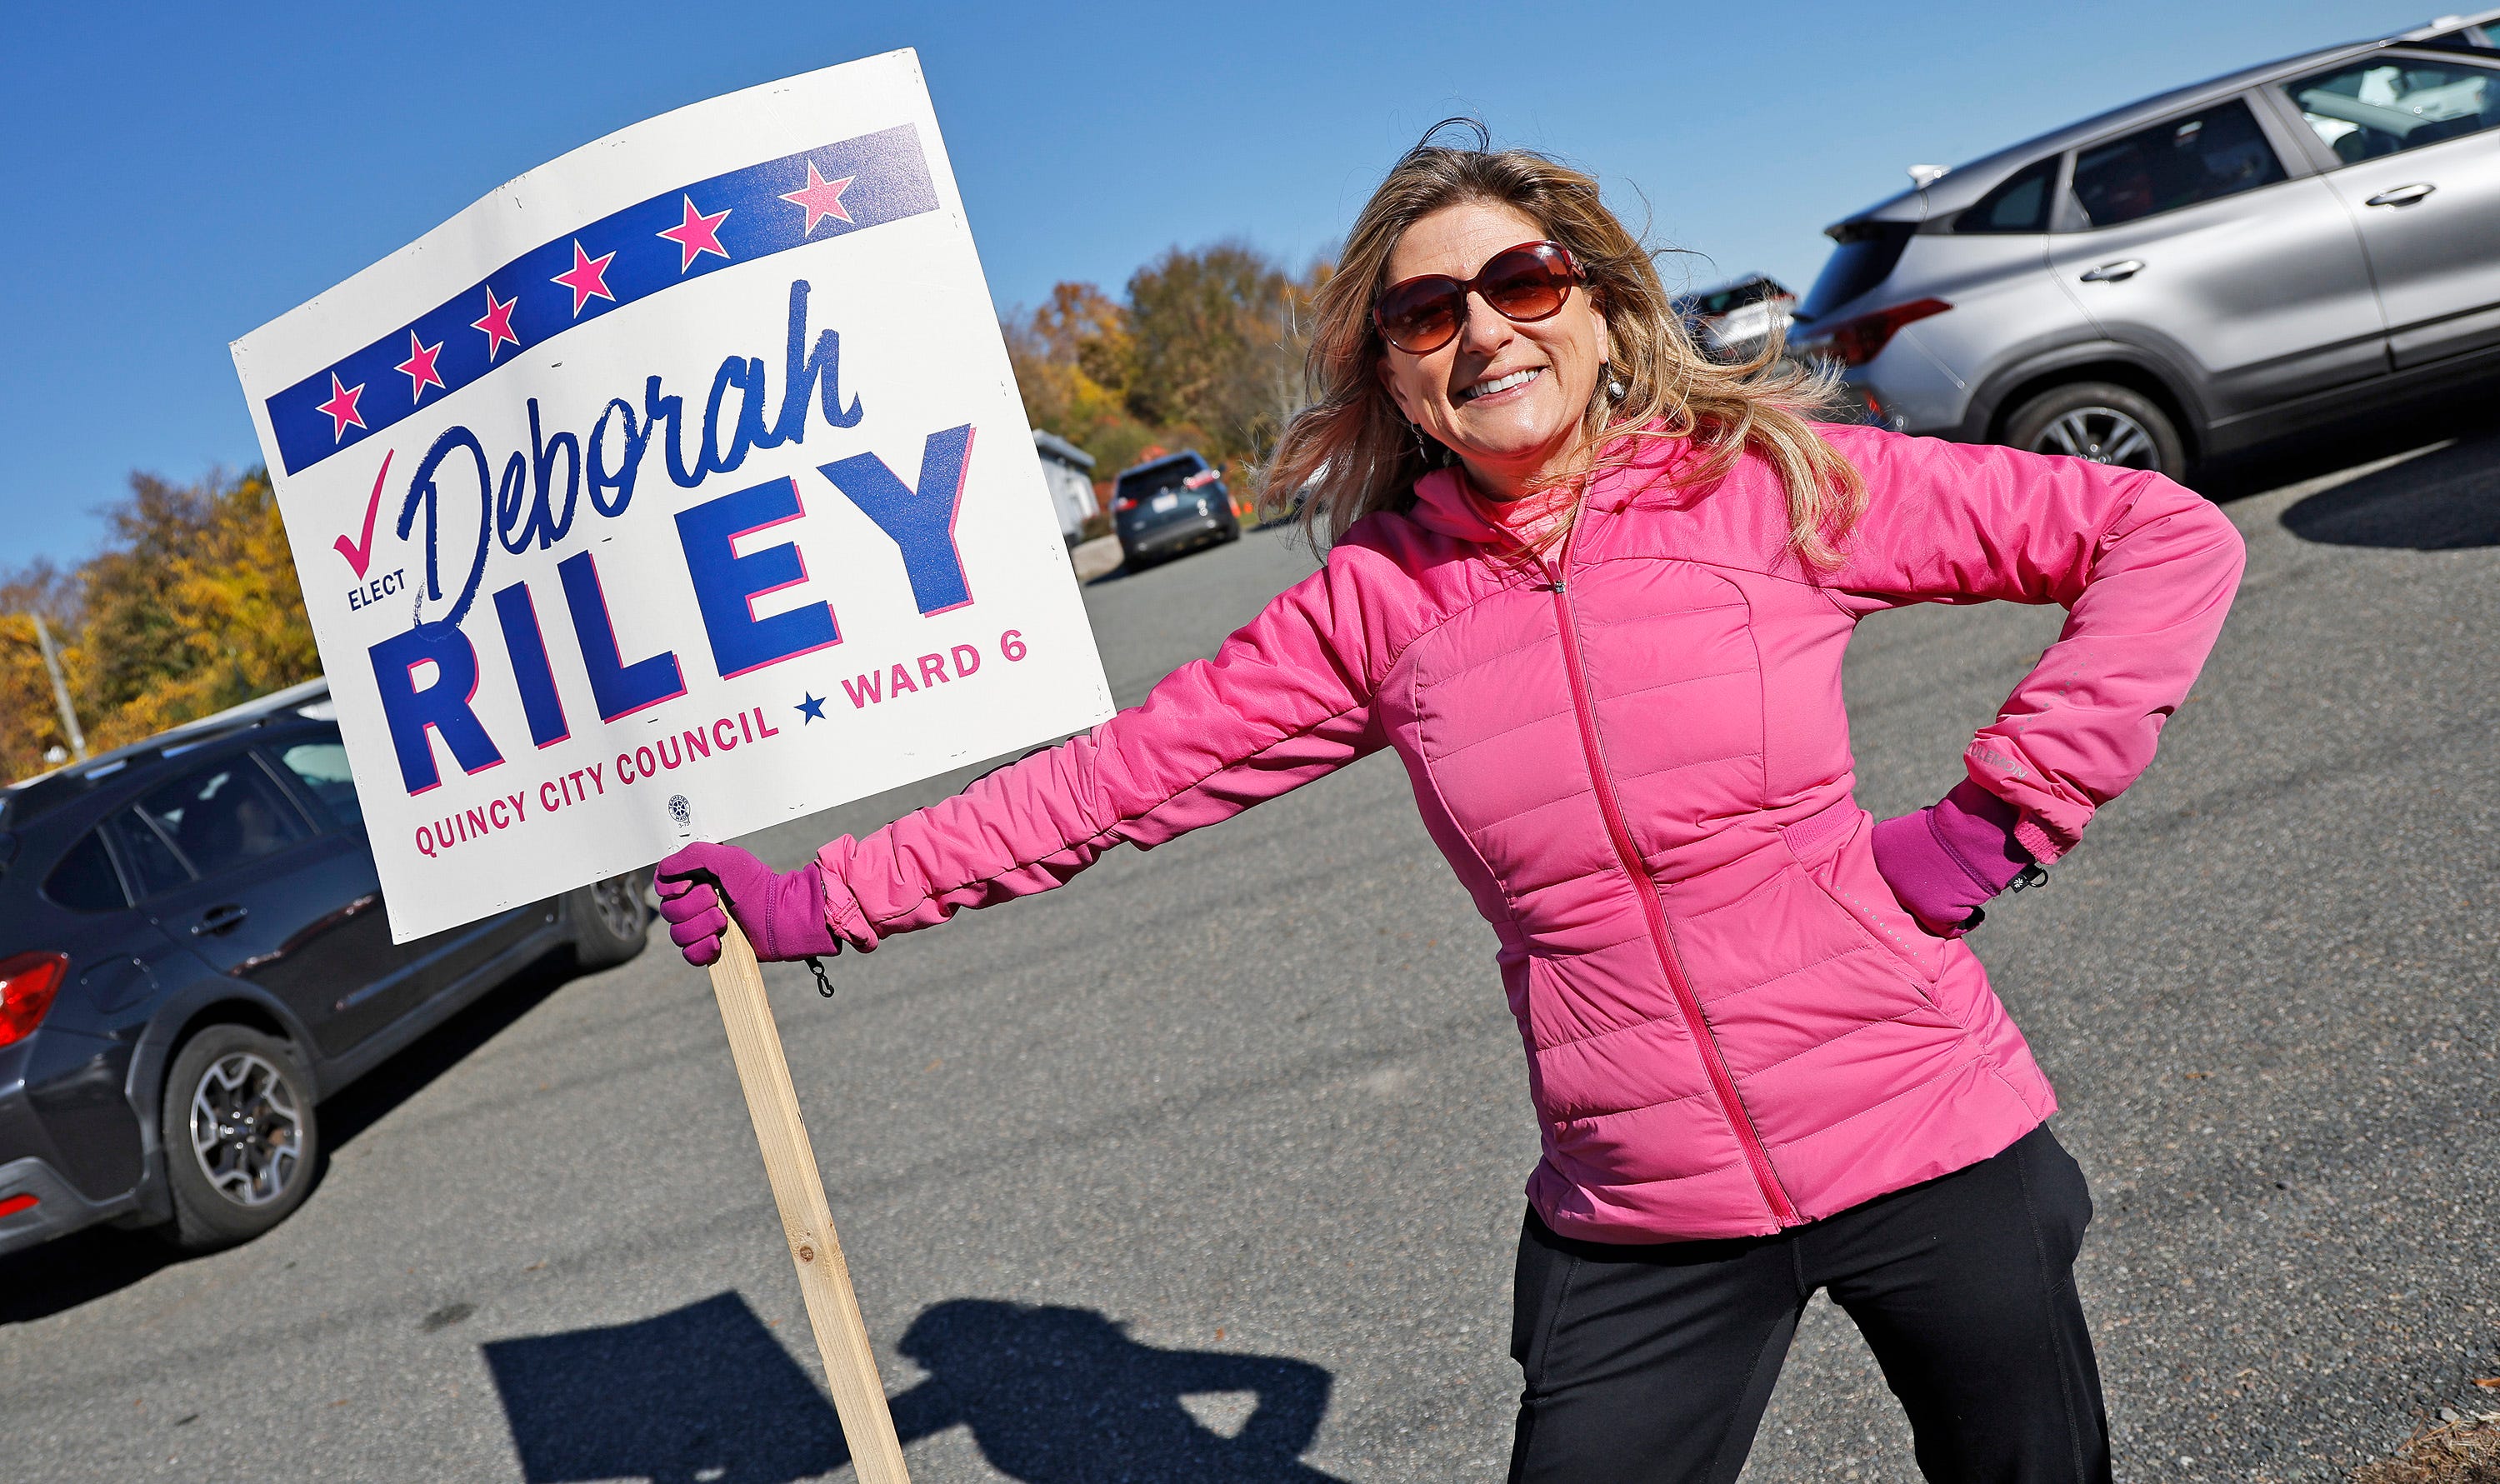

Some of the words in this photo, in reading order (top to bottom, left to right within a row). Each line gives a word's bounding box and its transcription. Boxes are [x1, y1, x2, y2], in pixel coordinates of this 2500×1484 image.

[347, 568, 406, 612] ELECT
[398, 279, 864, 640] Deborah
[368, 422, 977, 798] RILEY
[415, 790, 526, 859] QUINCY
[539, 762, 605, 813] CITY
[616, 707, 780, 786] COUNCIL
[840, 644, 982, 710] WARD
[1000, 629, 1028, 662] 6
